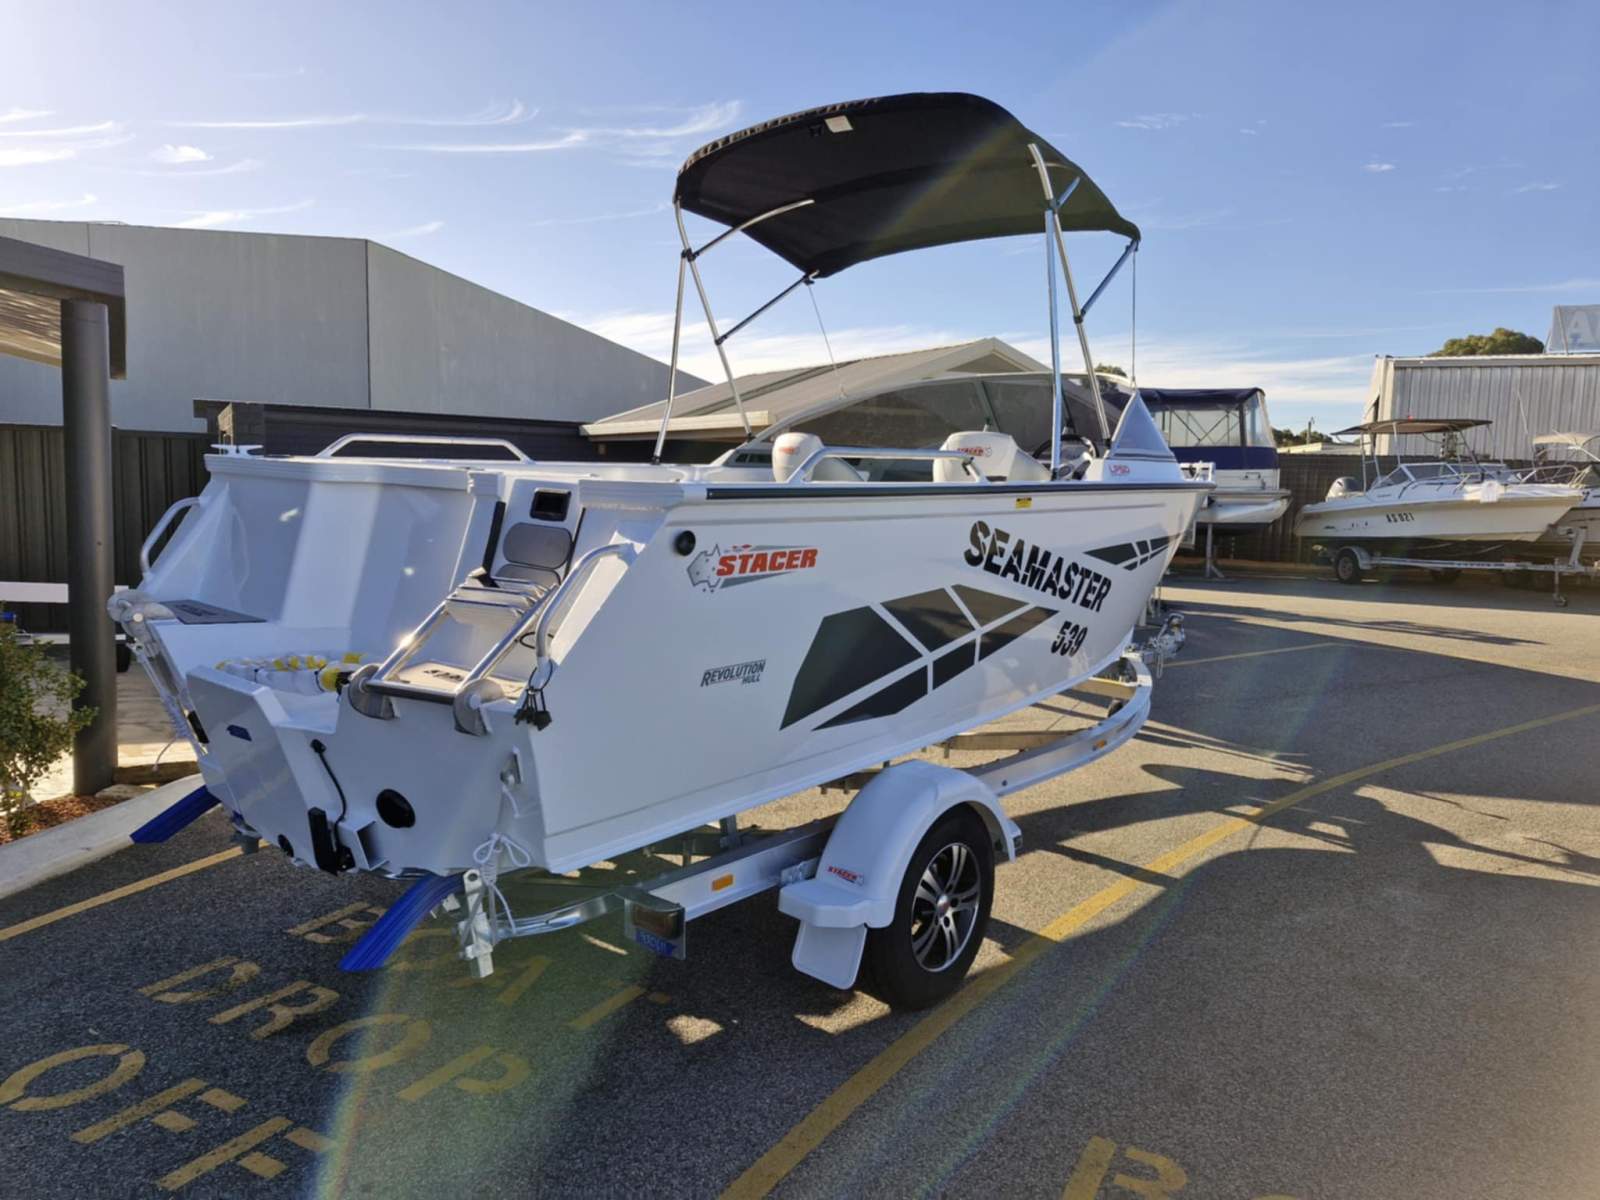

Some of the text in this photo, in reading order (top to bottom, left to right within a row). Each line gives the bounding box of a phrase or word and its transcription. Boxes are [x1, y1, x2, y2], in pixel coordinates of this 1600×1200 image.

[716, 549, 818, 577] STACER
[964, 520, 1112, 613] SEAMASTER
[1051, 620, 1088, 657] 539
[700, 659, 766, 687] REVOLUTION
[136, 956, 531, 1102] DROP
[0, 1043, 334, 1192] OFF
